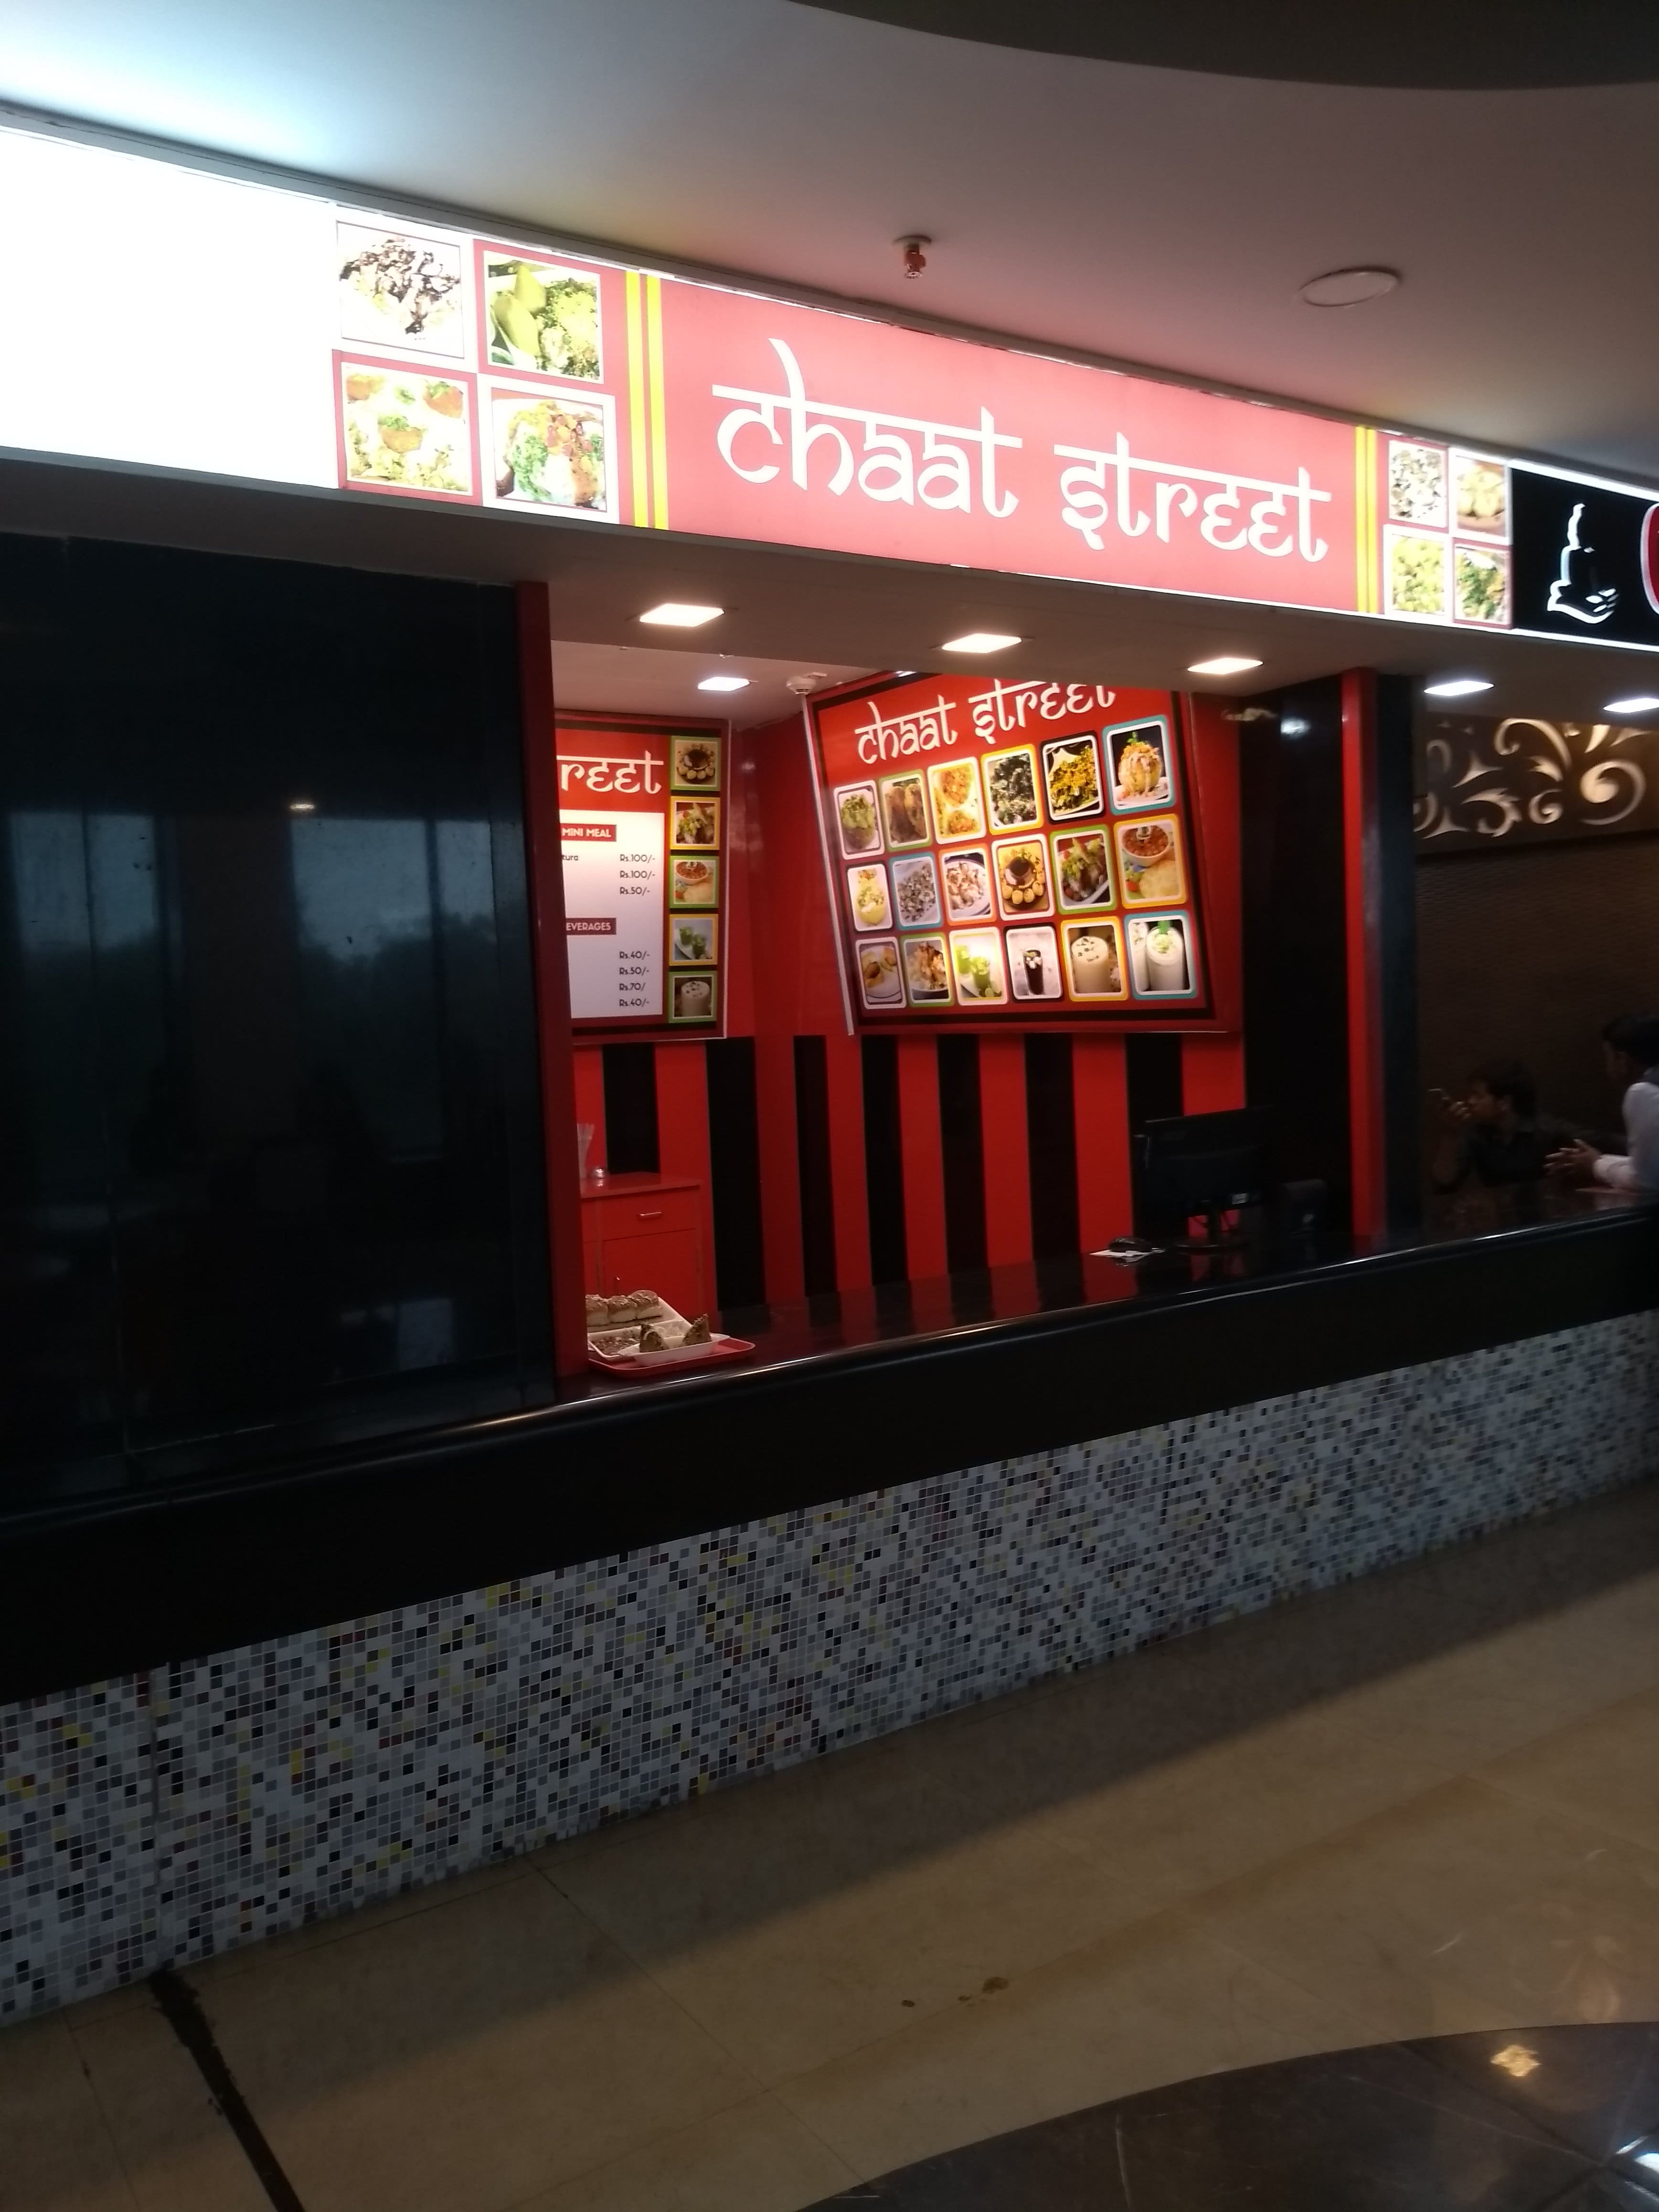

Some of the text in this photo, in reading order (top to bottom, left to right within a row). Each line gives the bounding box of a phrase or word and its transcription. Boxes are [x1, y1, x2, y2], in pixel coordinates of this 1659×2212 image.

[712, 338, 1332, 562] chaat street
[855, 695, 958, 764] chaat
[556, 750, 664, 794] reet
[562, 828, 612, 838] MINI MEAL
[619, 854, 656, 863] Rs.100/-
[619, 870, 656, 880] Rs.100/-
[619, 886, 650, 896] Rs.50/-
[565, 922, 612, 931] EVERAGES
[619, 950, 650, 960] Rs.40/-
[619, 967, 649, 976] Rs.50/-
[619, 982, 646, 992] Rs.70/
[619, 998, 649, 1008] Rs.40/-
